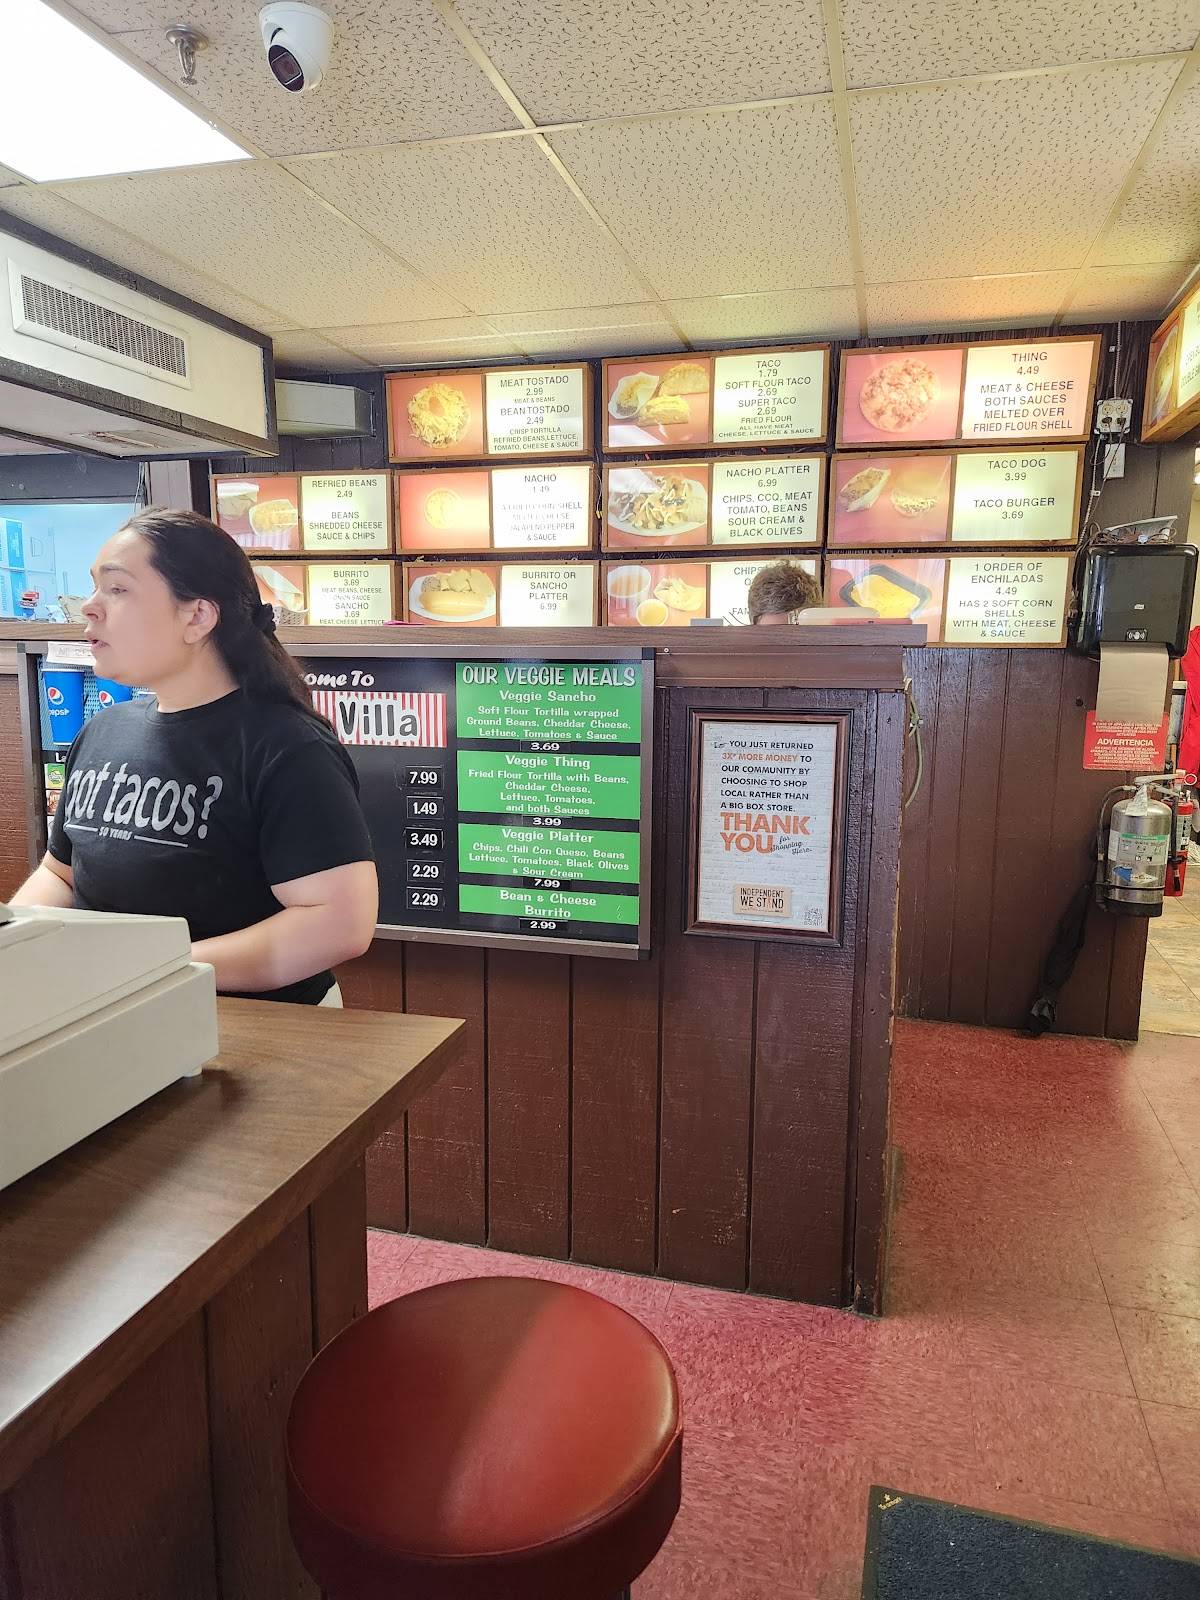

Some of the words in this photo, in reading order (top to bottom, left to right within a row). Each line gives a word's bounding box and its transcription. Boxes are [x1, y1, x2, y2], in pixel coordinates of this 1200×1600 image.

[1012, 351, 1048, 362] THING
[756, 359, 781, 369] TACO
[758, 368, 778, 378] 1.79
[1016, 365, 1040, 375] 4.49
[500, 378, 524, 388] MEAT
[526, 375, 569, 386] TOSTADO
[725, 380, 750, 390] SOFT
[752, 378, 784, 388] FLOUR
[786, 376, 811, 386] TACO
[980, 383, 1012, 394] MEAT
[1015, 383, 1022, 392] &
[1026, 380, 1075, 392] CHEESE
[526, 387, 544, 396] 2.99
[757, 387, 778, 397] 2.69
[738, 398, 770, 408] SUPER
[772, 396, 797, 406] TACO
[984, 396, 1016, 407] BOTH
[1019, 394, 1067, 405] SAUCES
[500, 407, 525, 416] BEAN
[527, 404, 570, 415] TOSTADO
[756, 406, 777, 416] 2.69
[984, 408, 1029, 419] MELTED
[1032, 407, 1065, 417] OVER
[526, 416, 544, 425] 2.49
[740, 416, 764, 424] FRIED
[765, 415, 792, 423] FLOUR
[973, 423, 1002, 432] FRIED
[1004, 421, 1038, 431] FLOUR
[1041, 419, 1073, 430] SHELL
[988, 460, 1017, 469] TACO
[1021, 458, 1047, 468] DOG
[726, 467, 761, 478] NACHO
[764, 465, 810, 475] PLATTER
[1004, 472, 1027, 481] 3.99
[312, 479, 346, 488] REFRIED
[349, 479, 377, 487] BEANS
[524, 474, 557, 483] NACHO
[757, 478, 778, 488] 6.99
[337, 490, 353, 498] 2.49
[973, 499, 1003, 508] TACO
[1006, 497, 1055, 508] BURGER
[727, 505, 770, 515] TOMATO,
[772, 503, 808, 513] BEANS
[331, 511, 360, 519] BEANS
[728, 517, 756, 526] SOUR
[759, 515, 795, 525] CREAM
[798, 515, 805, 524] &
[1001, 510, 1024, 520] 3.69
[309, 522, 350, 530] SHREDDED
[352, 521, 383, 529] CHEESE
[316, 532, 343, 540] SAUCE
[352, 532, 376, 540] CHIPS
[729, 528, 763, 538] BLACK
[766, 526, 803, 536] OLIVES
[975, 563, 979, 571] 1
[983, 562, 1023, 572] ORDER
[1026, 562, 1043, 571] OF
[333, 570, 369, 578] BURRITO
[522, 571, 560, 579] BURRITO
[563, 571, 576, 579] OR
[971, 574, 1044, 584] ENCHILADAS
[530, 582, 568, 590] SANCHO
[995, 586, 1018, 595] 4.49
[529, 592, 568, 601] PLATTER
[335, 602, 369, 610] SANCHO
[540, 602, 557, 610] 6.99
[1022, 599, 1053, 607] CORN
[981, 620, 1011, 628] MEAT,
[303, 673, 347, 688] ome
[351, 670, 375, 687] To
[462, 666, 498, 685] OUR
[504, 667, 565, 686] VEGGIE
[572, 667, 636, 687] MEALS
[499, 690, 542, 704] Veggie
[547, 690, 596, 702] Sancho
[478, 705, 500, 716] Soft
[504, 706, 529, 716] Flour
[534, 707, 570, 717] Tortilla
[574, 708, 619, 719] wrapped
[338, 700, 418, 737] Villa
[530, 742, 560, 751] 3.69
[729, 740, 747, 748] YOU
[749, 741, 768, 749] JUST
[770, 742, 814, 750] RETURNED
[1097, 738, 1154, 746] ADVERTENCIA
[505, 754, 548, 768] Veggie
[553, 756, 591, 770] Thing
[742, 766, 797, 775] COMMUNITY
[798, 767, 811, 775] BY
[409, 771, 438, 785] 7.99
[468, 769, 494, 779] Fried
[497, 770, 523, 780] Flour
[527, 771, 562, 781] Tortilla
[566, 773, 590, 782] with
[594, 774, 629, 784] Beans,
[721, 777, 767, 786] CHOOSING
[720, 789, 747, 797] LOCAL
[749, 791, 781, 799] RATHER
[784, 792, 809, 800] THAN
[64, 761, 112, 824] got
[102, 762, 223, 840] tacos?
[412, 801, 438, 815] 1.49
[505, 804, 524, 812] and
[527, 804, 550, 813] both
[553, 805, 590, 815] Sauces
[729, 802, 744, 810] BIG
[766, 804, 796, 812] STORE.
[532, 817, 562, 826] 3.99
[720, 812, 811, 835] THANK
[99, 826, 108, 836] 50
[109, 828, 133, 841] YEARS
[502, 828, 544, 841] Veggie
[549, 831, 595, 843] Platter
[410, 833, 438, 847] 3.49
[720, 832, 774, 854] YOU
[412, 864, 439, 878] 2.29
[522, 867, 546, 877] Sour
[550, 868, 583, 878] Cream
[533, 879, 560, 888] 7.99
[499, 889, 532, 901] Bean
[537, 894, 544, 902] &
[549, 892, 597, 906] Cheese
[740, 887, 785, 898] INDEPENDENT
[411, 893, 439, 907] 2.29
[740, 896, 754, 907] WE
[524, 905, 572, 918] Burrito
[530, 921, 556, 930] 2.99
